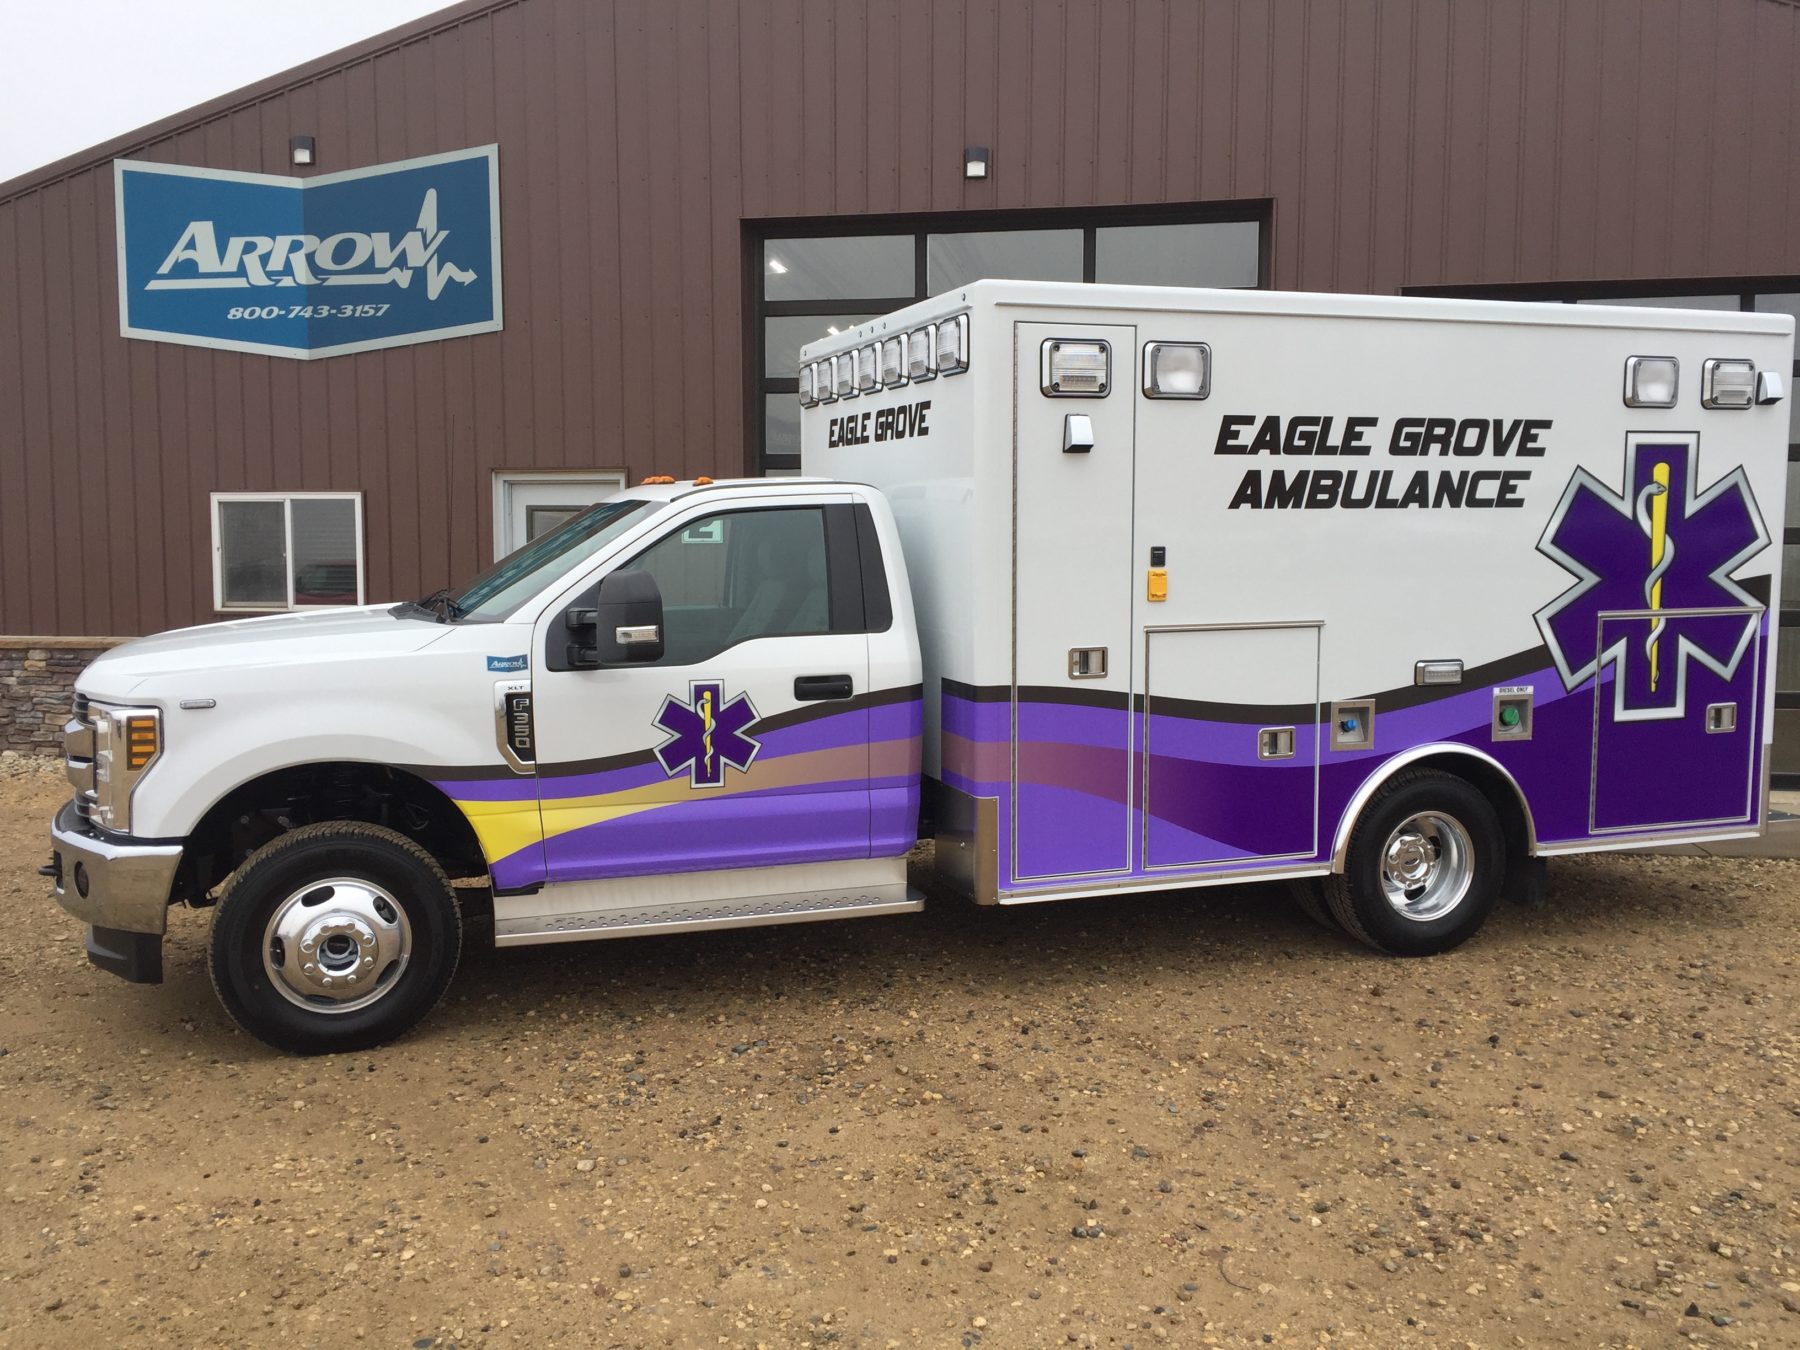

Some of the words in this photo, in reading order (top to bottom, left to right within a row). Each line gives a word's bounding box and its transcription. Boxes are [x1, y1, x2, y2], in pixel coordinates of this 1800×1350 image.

[155, 220, 450, 287] ARROW
[227, 303, 392, 320] 800-743-3157
[828, 411, 872, 449] EAGLE
[874, 400, 932, 442] GROVE
[1213, 414, 1379, 456] EAGLE
[1388, 417, 1554, 457] GROVE
[1227, 469, 1532, 509] AMBULANCE
[513, 698, 530, 749] F350
